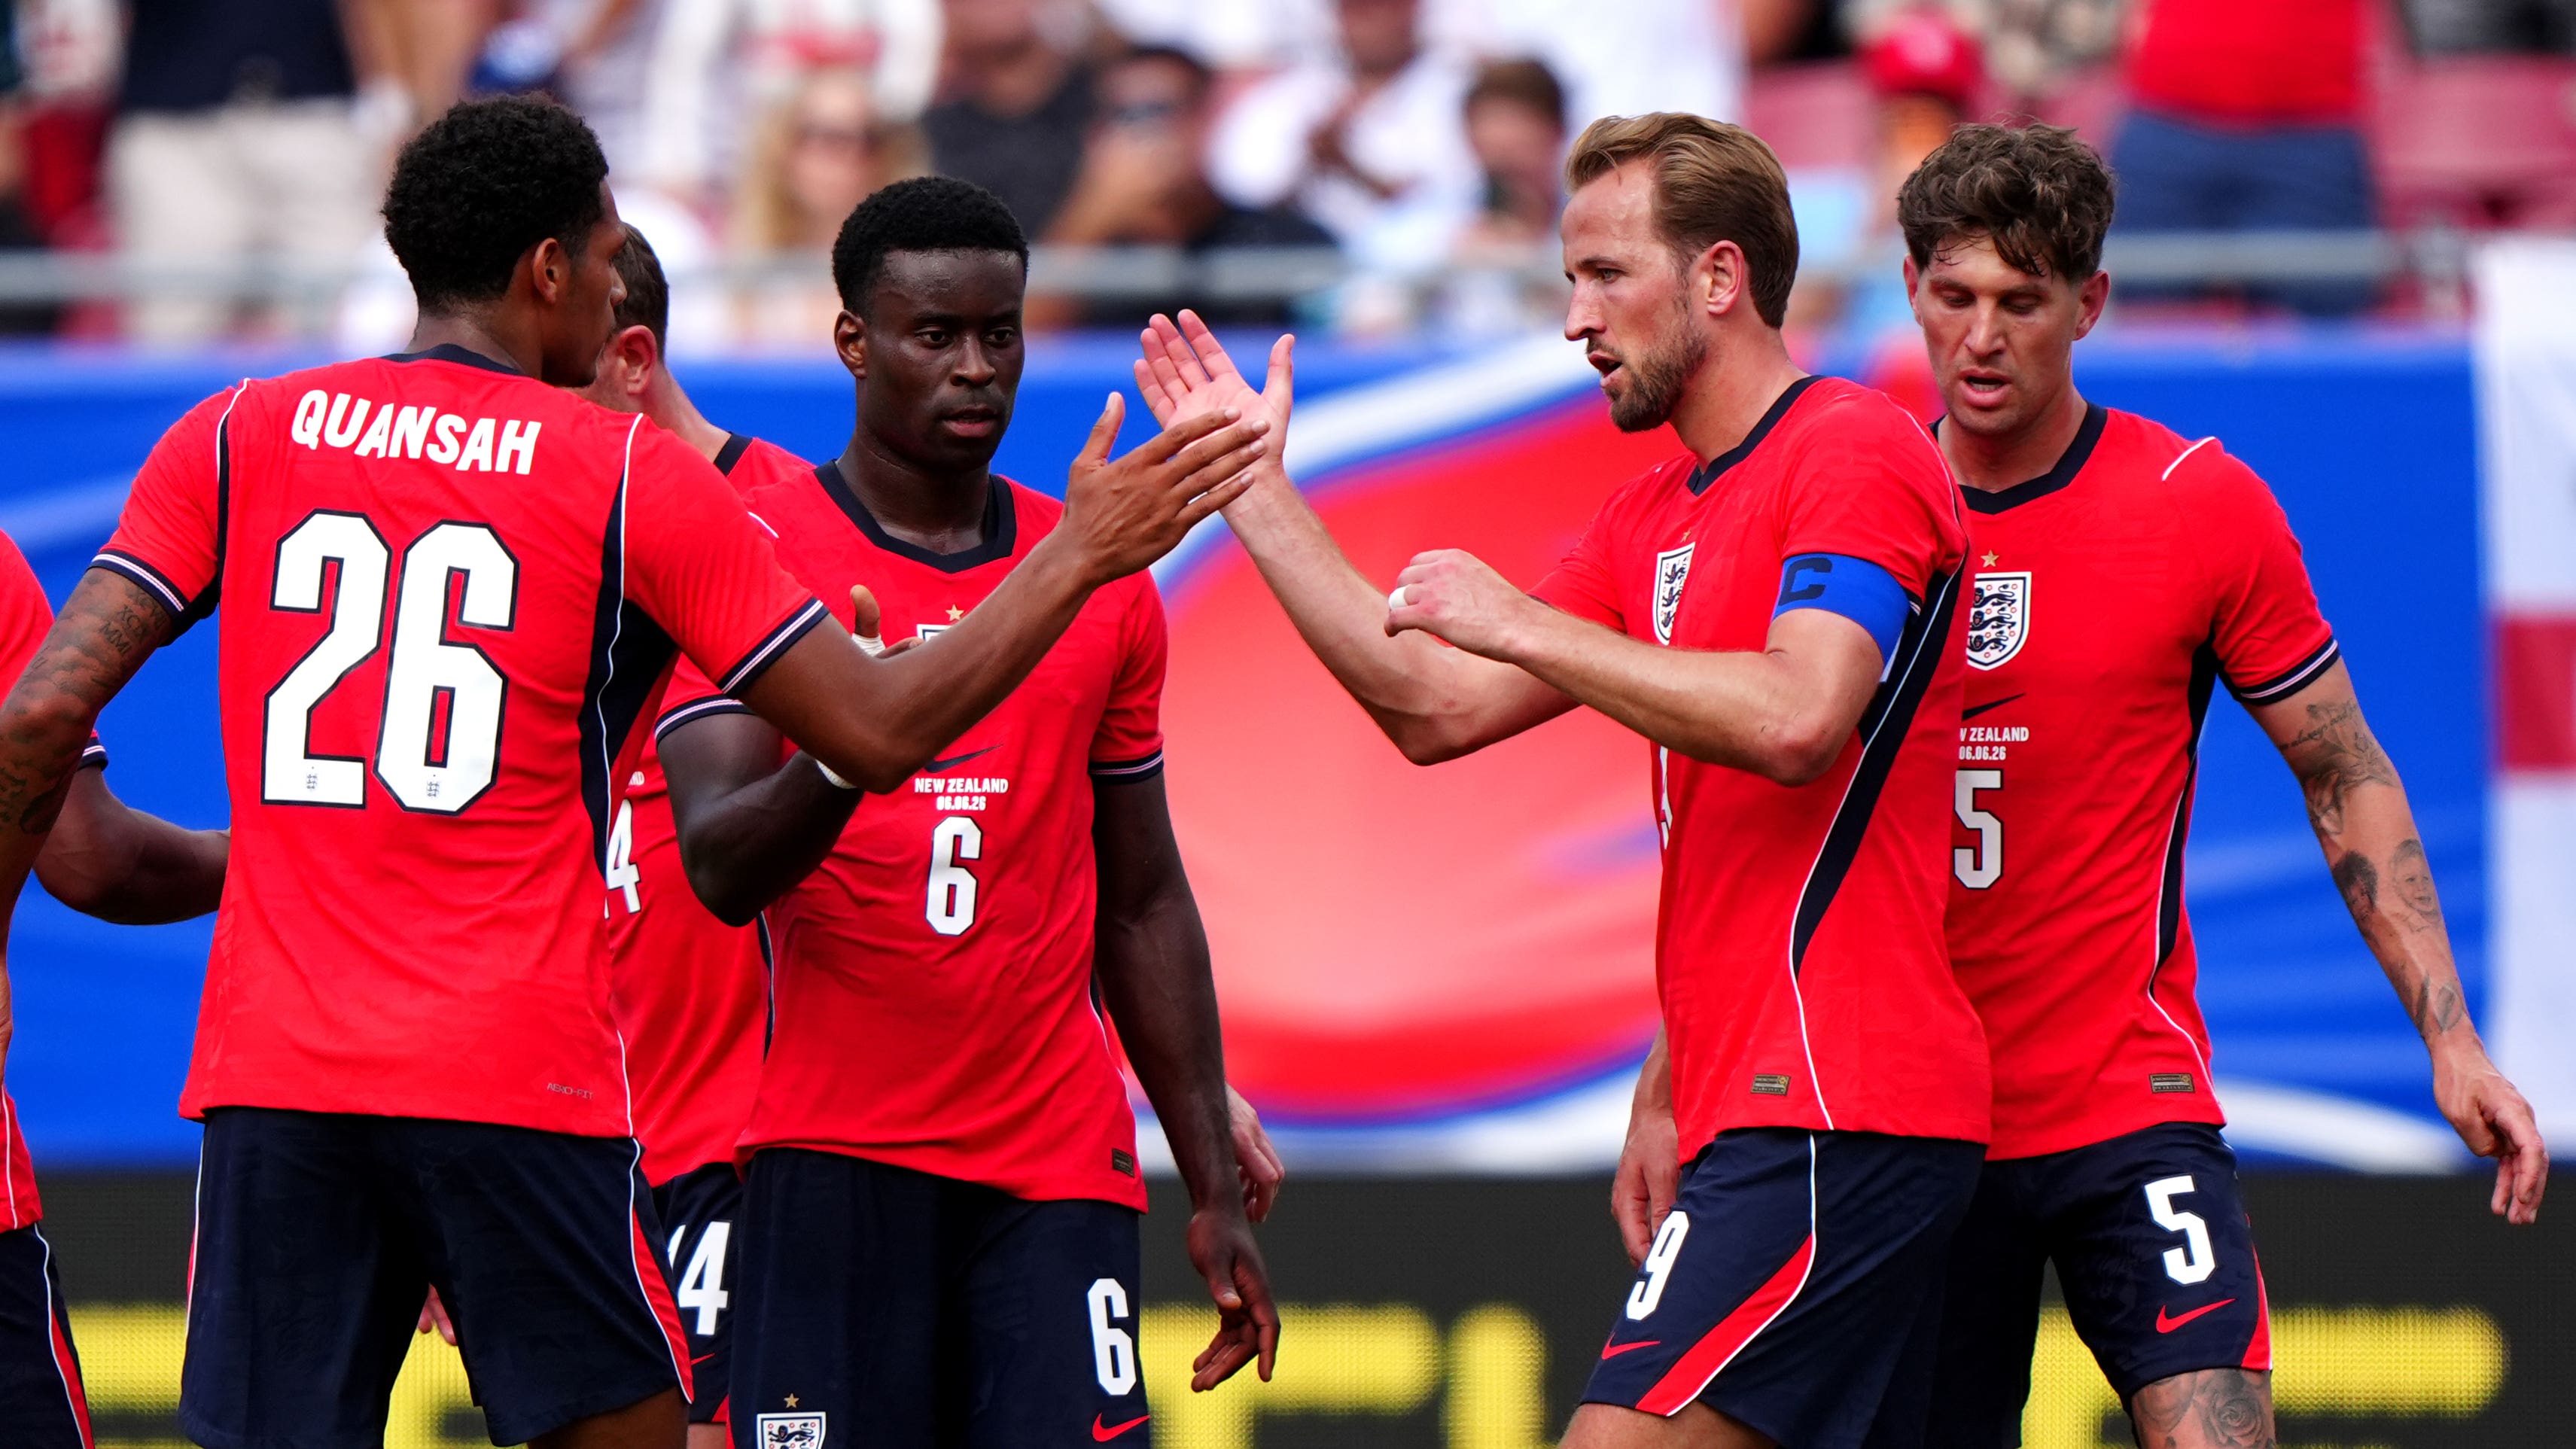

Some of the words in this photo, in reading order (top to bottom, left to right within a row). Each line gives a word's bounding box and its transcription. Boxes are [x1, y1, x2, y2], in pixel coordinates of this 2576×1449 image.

[291, 389, 541, 475] QUANSAH
[1778, 557, 1832, 605] C
[261, 508, 519, 815] 26
[915, 778, 945, 793] NEW
[947, 778, 1009, 793] ZEALAND
[1959, 745, 2007, 761] 06.06.26
[1969, 726, 2030, 742] ZEALAND
[604, 798, 641, 920] 4
[936, 795, 987, 811] 06.06.26
[1953, 768, 2003, 890] 5
[925, 815, 982, 936] 6
[1626, 1210, 1690, 1322] 9
[2145, 1174, 2215, 1286] 5
[1086, 1277, 1137, 1396] 6
